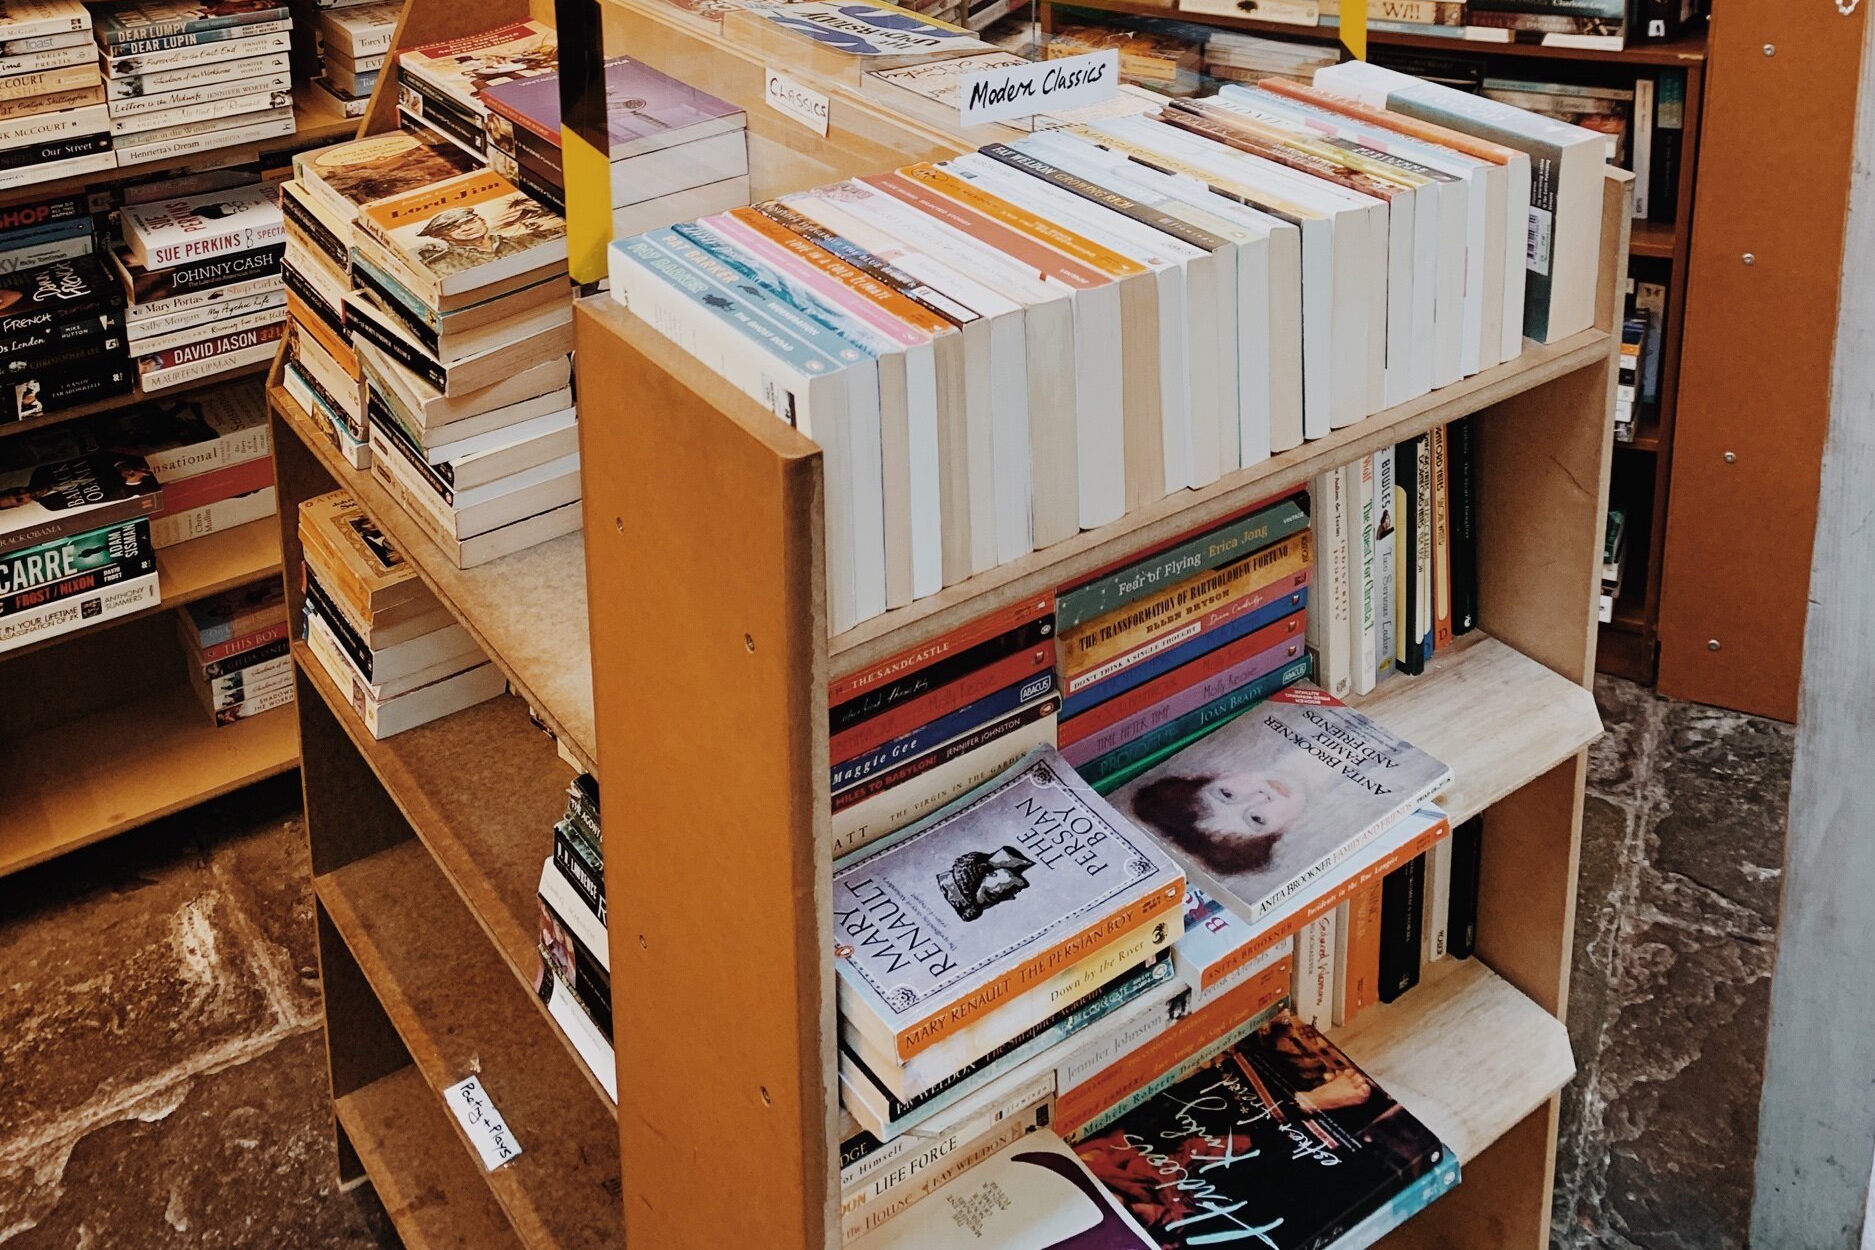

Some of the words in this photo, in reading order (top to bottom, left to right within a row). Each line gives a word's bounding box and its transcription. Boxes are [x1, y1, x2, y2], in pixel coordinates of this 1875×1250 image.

[118, 29, 147, 43] DEAR
[149, 22, 187, 40] LUMPY
[130, 40, 161, 54] DEAR
[163, 33, 197, 49] LUPIN
[769, 76, 827, 118] CLASSICS
[969, 75, 1035, 113] Modern
[1041, 59, 1107, 96] Classics
[41, 146, 62, 158] Our
[65, 141, 93, 154] Street
[173, 140, 200, 152] Dream
[1011, 153, 1056, 176] WELDON
[1054, 172, 1104, 200] GROWING
[1103, 193, 1136, 210] RICH
[155, 248, 181, 263] SUE
[185, 233, 242, 259] PERKINS
[685, 248, 741, 284] BARKER
[784, 238, 811, 255] LOVE
[852, 273, 894, 300] CLIMATE
[172, 260, 232, 288] JOHNNY
[236, 253, 273, 274] CASH
[3, 314, 52, 333] FRENCH
[145, 302, 171, 315] Mary
[173, 295, 204, 309] Portas
[174, 339, 216, 365] DAVID
[217, 331, 257, 355] JASON
[151, 365, 198, 388] MAUREEN
[200, 356, 237, 374] LIPMAN
[1381, 459, 1391, 509] BOWLES
[110, 530, 124, 558] ADAM
[124, 523, 139, 559] SISMAN
[1118, 577, 1145, 596] Fear
[1163, 553, 1202, 578] Flying
[1207, 538, 1239, 558] Erica
[1241, 524, 1269, 545] Jong
[1361, 525, 1373, 560] Quest
[0, 540, 78, 595] CARRÉ
[15, 583, 52, 608] FROST
[60, 575, 96, 596] NIXON
[104, 586, 145, 603] ANTHONY
[104, 595, 143, 611] SUMMERS
[1078, 628, 1098, 653] THE
[1100, 597, 1177, 646] TRANSFORMATION
[1189, 559, 1251, 605] BARTHOLOMEW
[1145, 612, 1183, 635] ELLEN
[1185, 588, 1231, 616] BRYSON
[1363, 580, 1374, 624] Christa
[43, 606, 79, 625] LIFETIME
[1162, 625, 1197, 648] THOUGHT
[223, 638, 252, 655] THIS
[255, 627, 279, 647] BOY
[851, 673, 874, 690] THE
[875, 642, 950, 678] SANDCASTLE
[1021, 678, 1050, 701] ABACUS
[1199, 703, 1227, 726] JOAN
[1229, 684, 1264, 712] BRADY
[946, 737, 980, 759] JENNIFER
[980, 717, 1022, 745] JOHNSTON
[1262, 714, 1342, 767] BROOKNER
[1312, 731, 1365, 768] FAMILY
[832, 752, 888, 786] Maggie
[891, 738, 918, 759] Gee
[1340, 763, 1394, 798] ANITA
[913, 789, 948, 811] VIRGIN
[1015, 796, 1109, 877] PERSIAN
[1052, 805, 1109, 847] BOY
[1015, 832, 1065, 871] THE
[1258, 890, 1287, 918] ANITA
[1286, 858, 1334, 894] BROOKNER
[835, 910, 912, 974] MARY
[843, 877, 958, 978] RENAULT
[1241, 921, 1294, 957] BROOKNER
[904, 1016, 947, 1050] MARY
[950, 977, 1012, 1030] RENAULT
[1019, 962, 1046, 985] THE
[1048, 928, 1104, 968] PERSIAN
[1106, 909, 1136, 938] BOY
[1050, 981, 1081, 1003] Down
[1117, 940, 1145, 965] River
[1066, 1048, 1110, 1081] Jennifer
[1114, 1014, 1163, 1052] Johnston
[459, 1081, 486, 1124] Poetry
[487, 1123, 513, 1159] Plays
[1083, 1105, 1129, 1138] Michèle
[1131, 1072, 1177, 1111] Roberts
[1159, 1092, 1261, 1174] Kinky
[858, 1141, 906, 1176] Himself
[875, 1168, 907, 1197] LIFE
[909, 1135, 959, 1177] FORCE
[1110, 1133, 1284, 1250] Hideous
